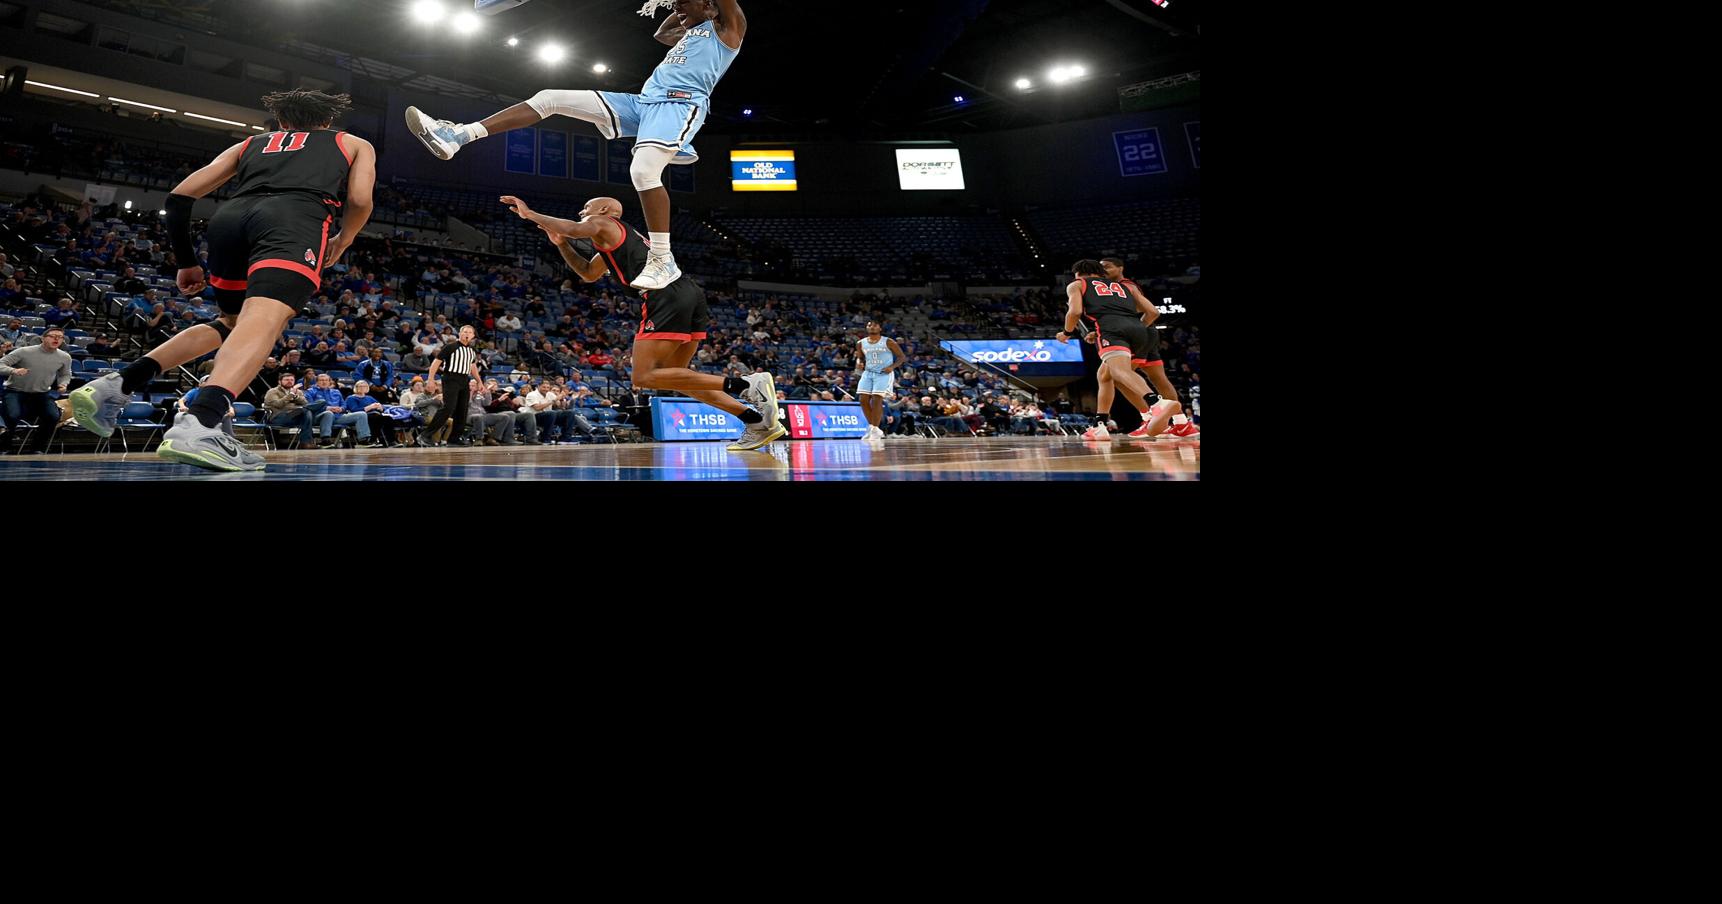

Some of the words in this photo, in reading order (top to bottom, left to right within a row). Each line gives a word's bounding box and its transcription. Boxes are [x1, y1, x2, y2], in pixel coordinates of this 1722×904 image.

[262, 131, 310, 154] 11
[1123, 143, 1157, 161] 22
[1092, 280, 1127, 299] 24
[971, 346, 1052, 362] sodexo
[688, 414, 726, 426] THSB
[829, 415, 859, 425] THSB
